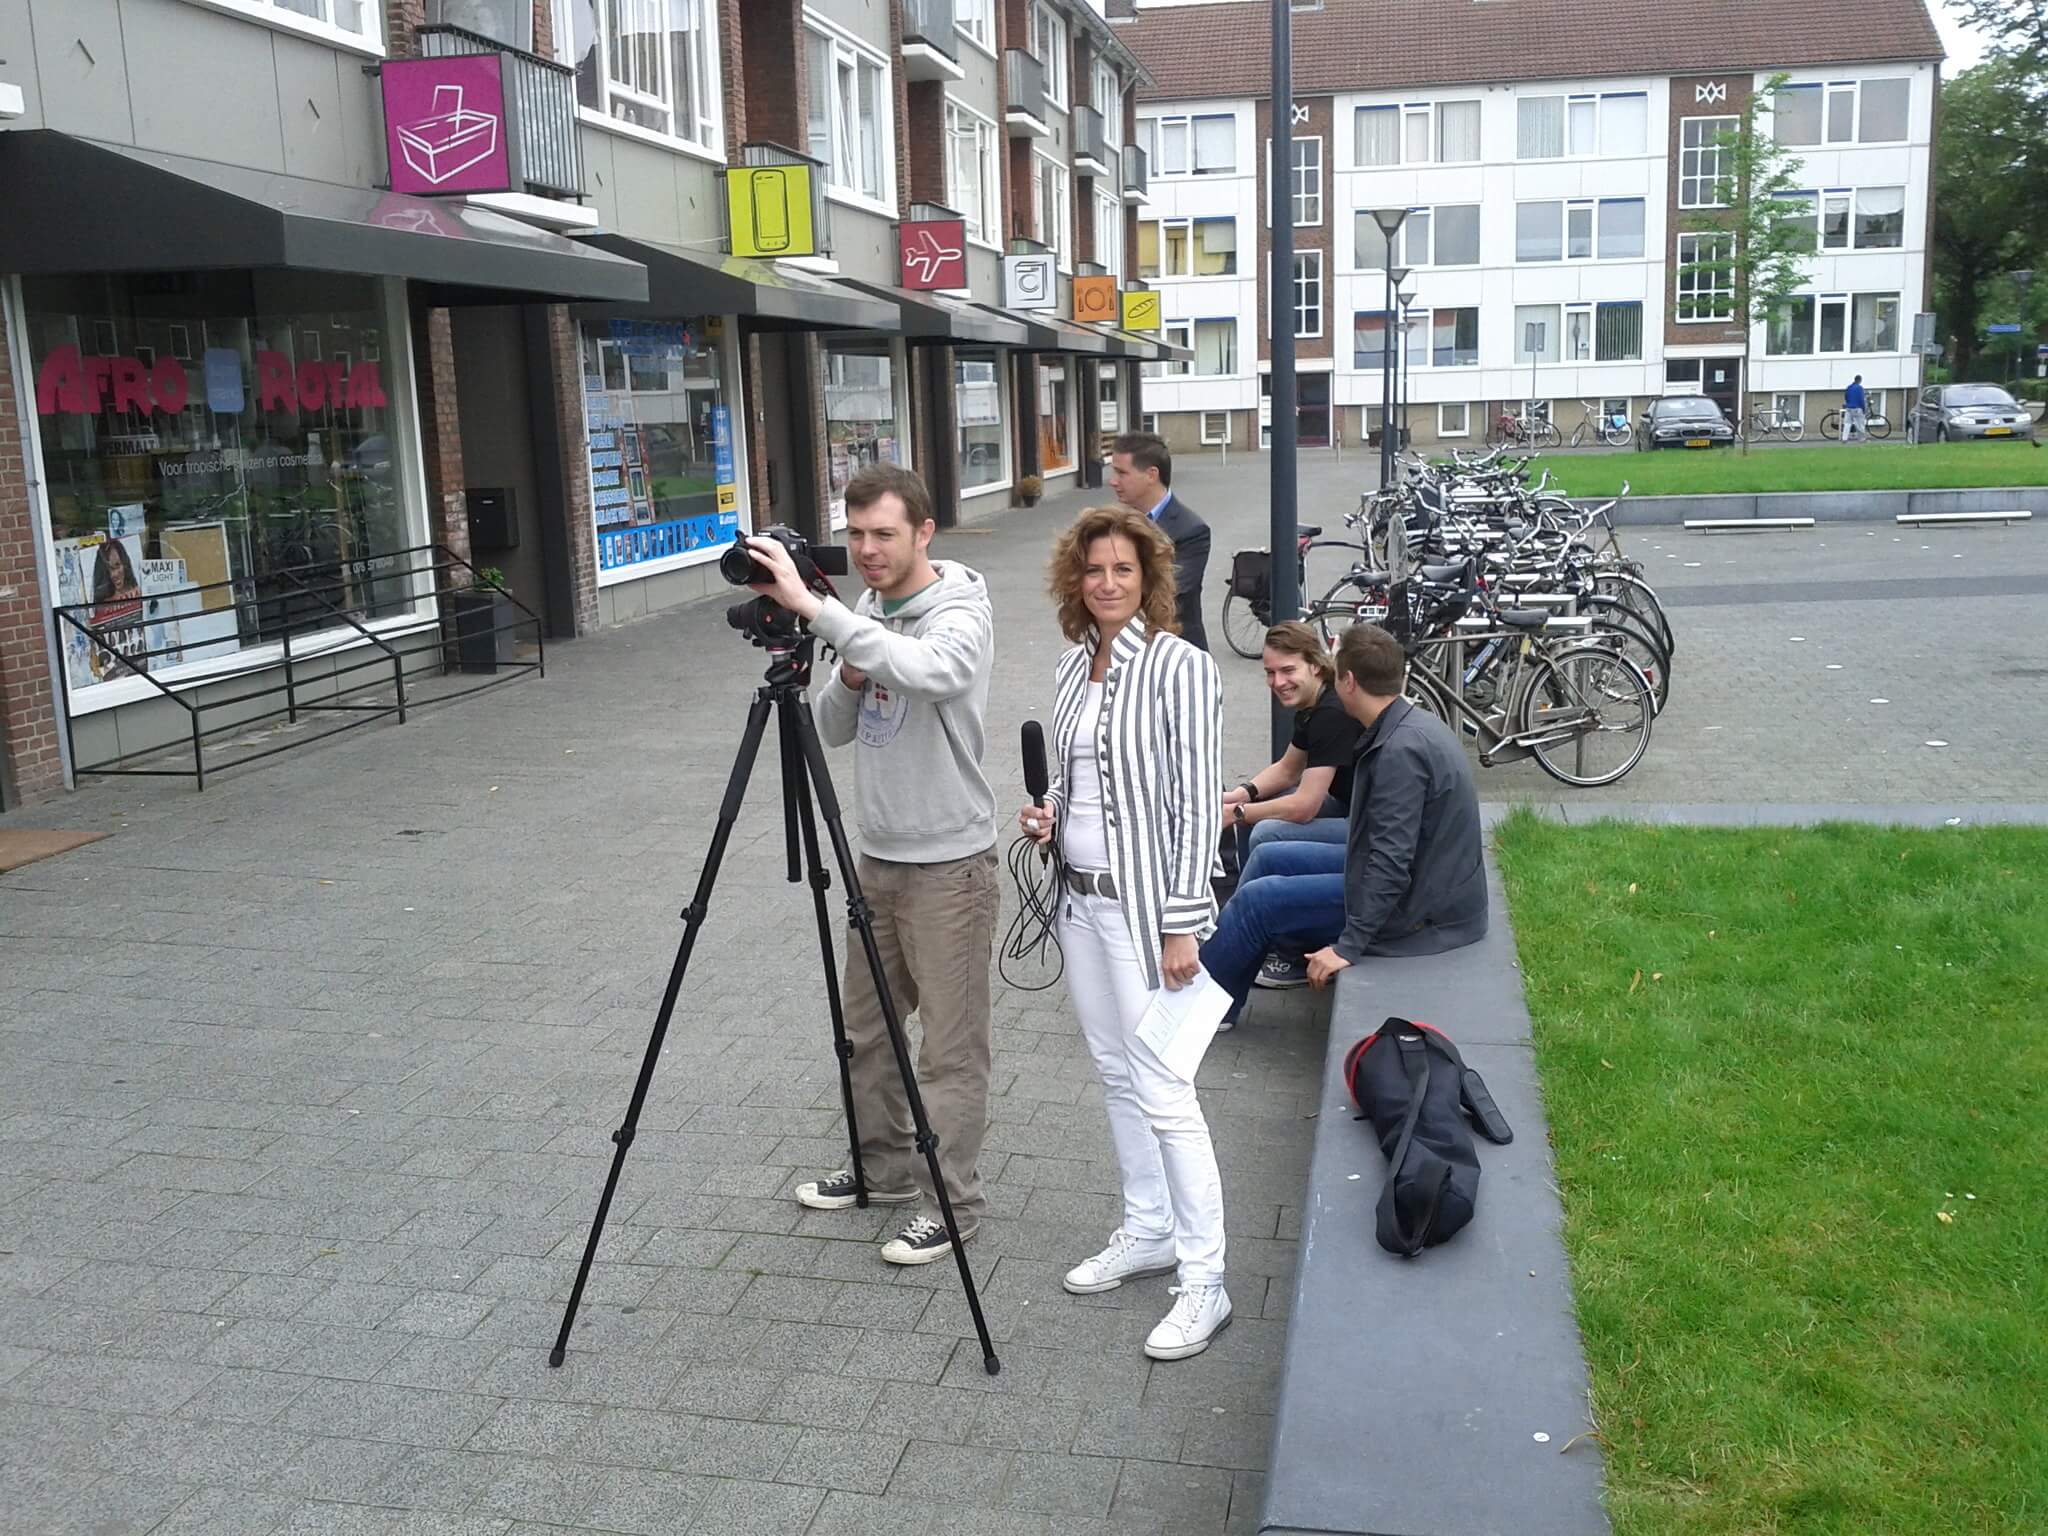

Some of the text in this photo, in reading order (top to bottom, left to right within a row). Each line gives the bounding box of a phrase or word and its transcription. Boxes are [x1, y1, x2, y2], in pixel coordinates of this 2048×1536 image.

[36, 343, 388, 416] AFRO ROYAL
[158, 461, 184, 478] Voor
[266, 456, 278, 467] en
[151, 561, 174, 573] MAXI
